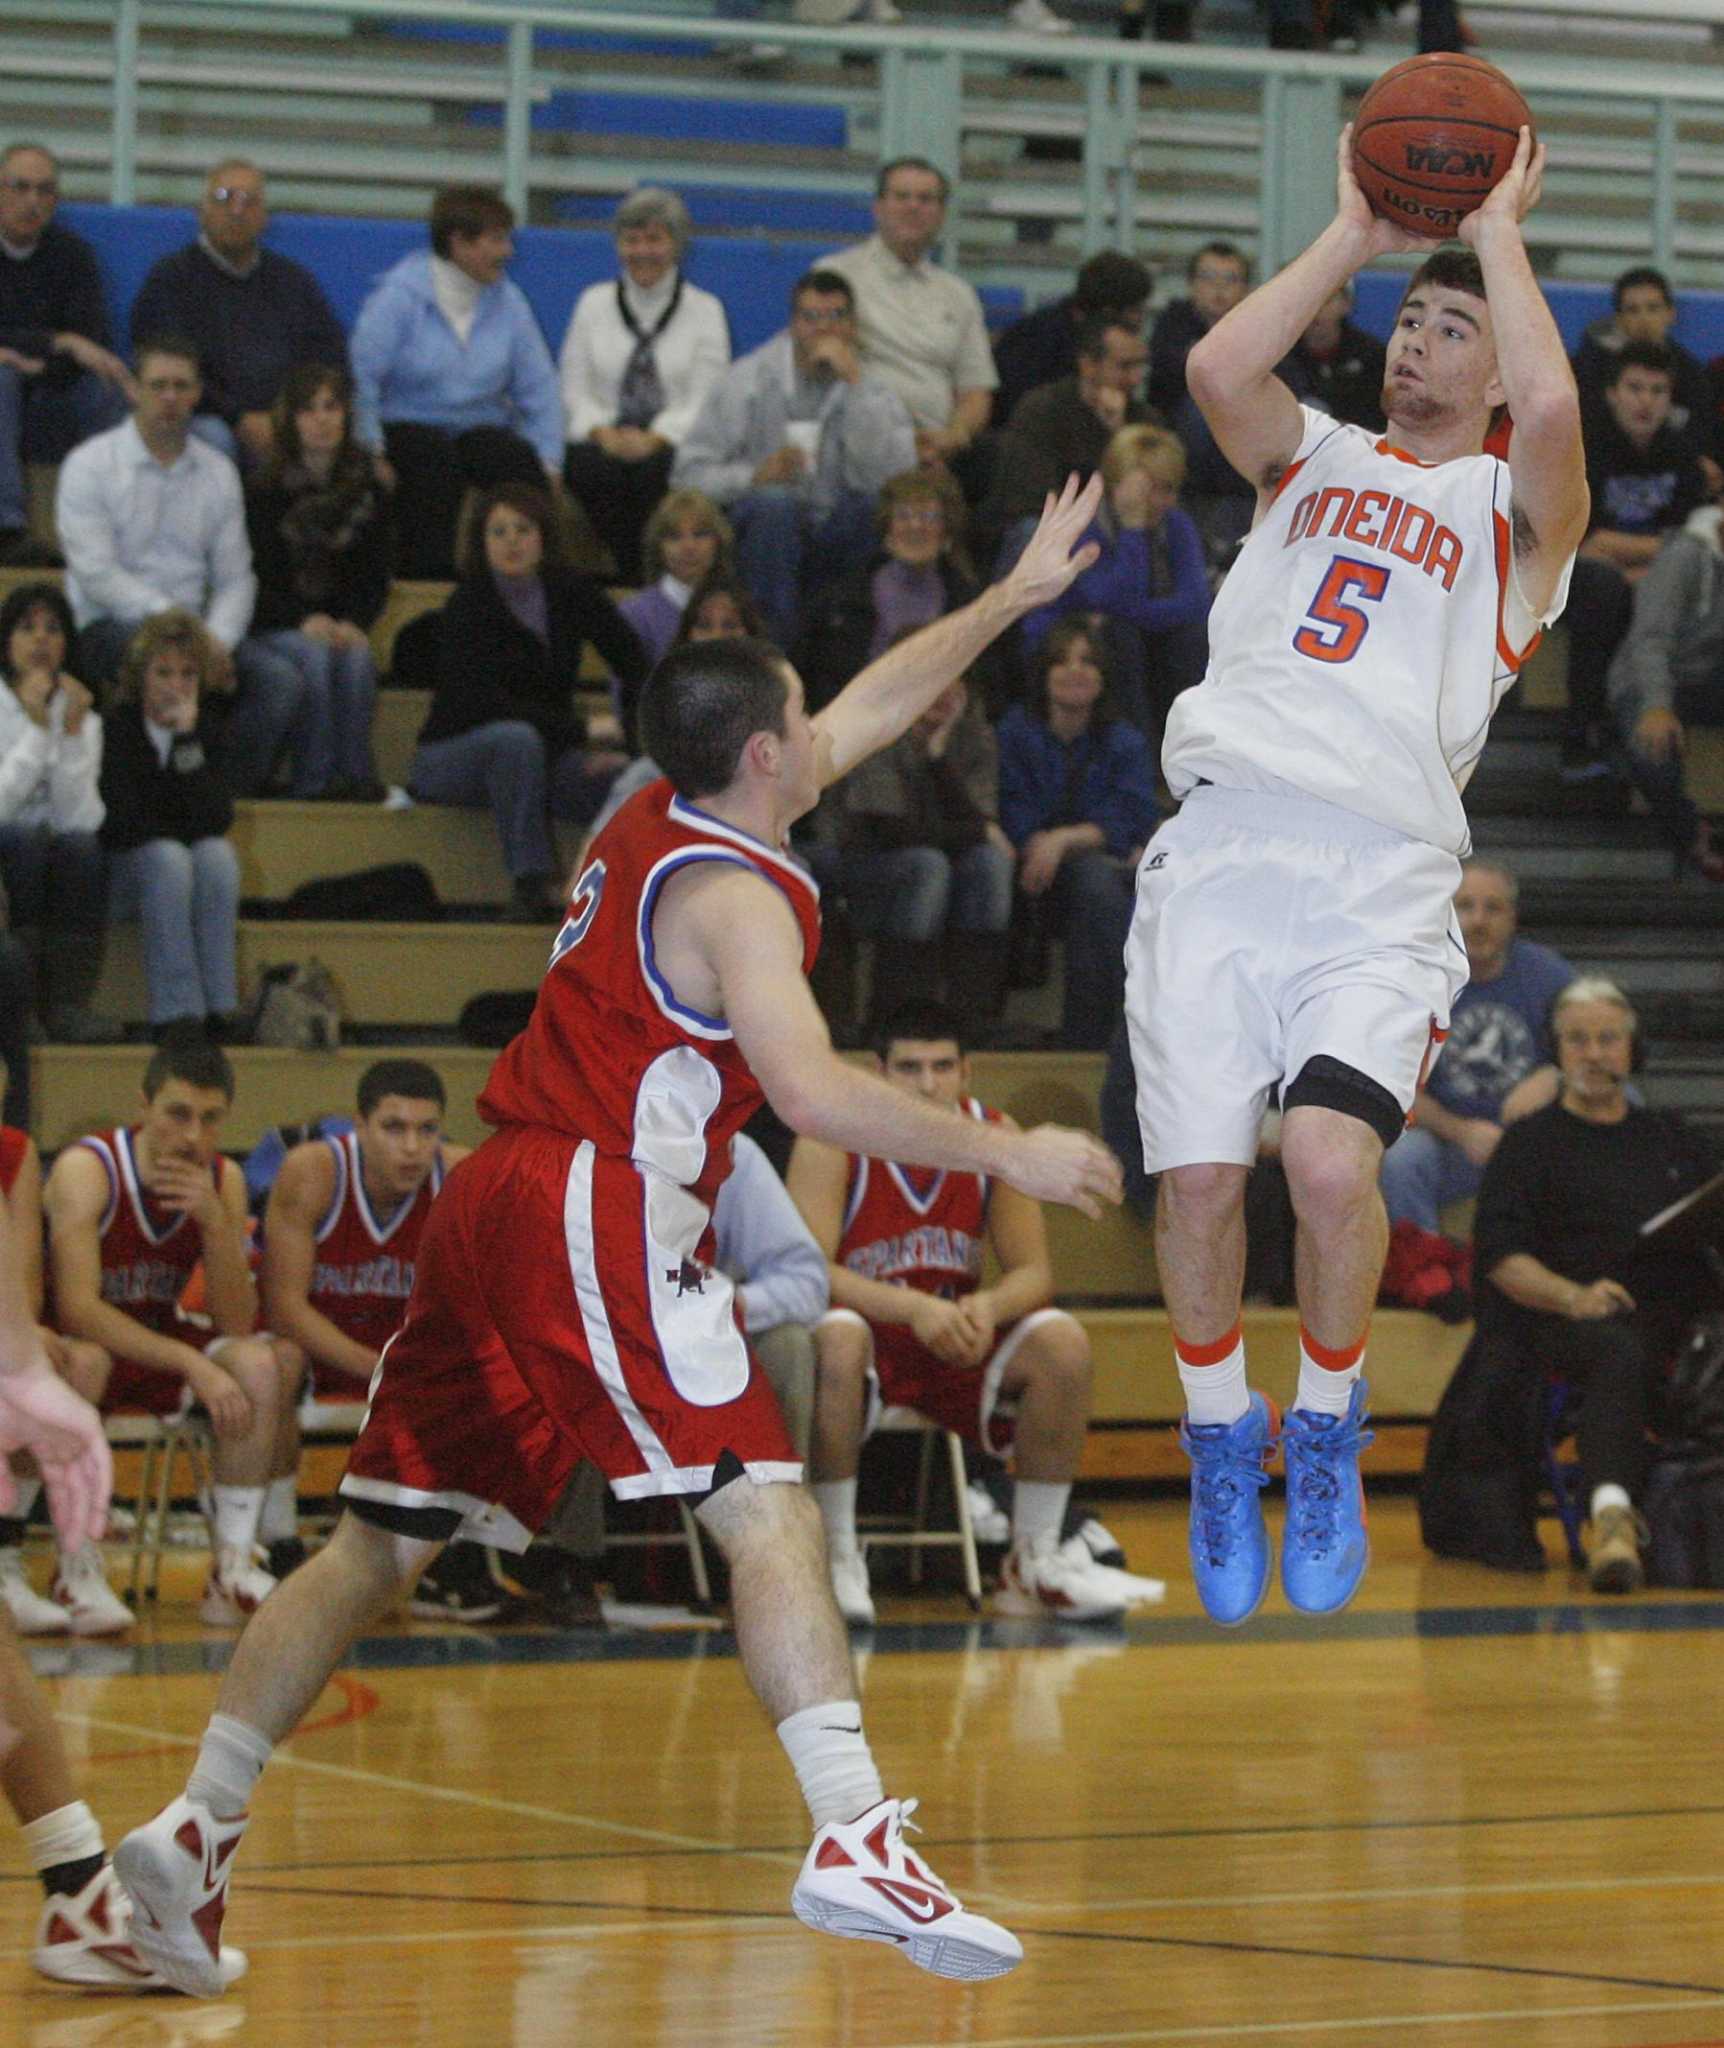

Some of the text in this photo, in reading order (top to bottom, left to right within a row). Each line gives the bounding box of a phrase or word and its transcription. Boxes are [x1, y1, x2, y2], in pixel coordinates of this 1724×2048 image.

[1383, 188, 1466, 228] ilson
[1405, 143, 1496, 179] NCAA
[1283, 486, 1464, 593] ONEIDA
[1292, 553, 1392, 664] 5
[546, 858, 607, 973] 2
